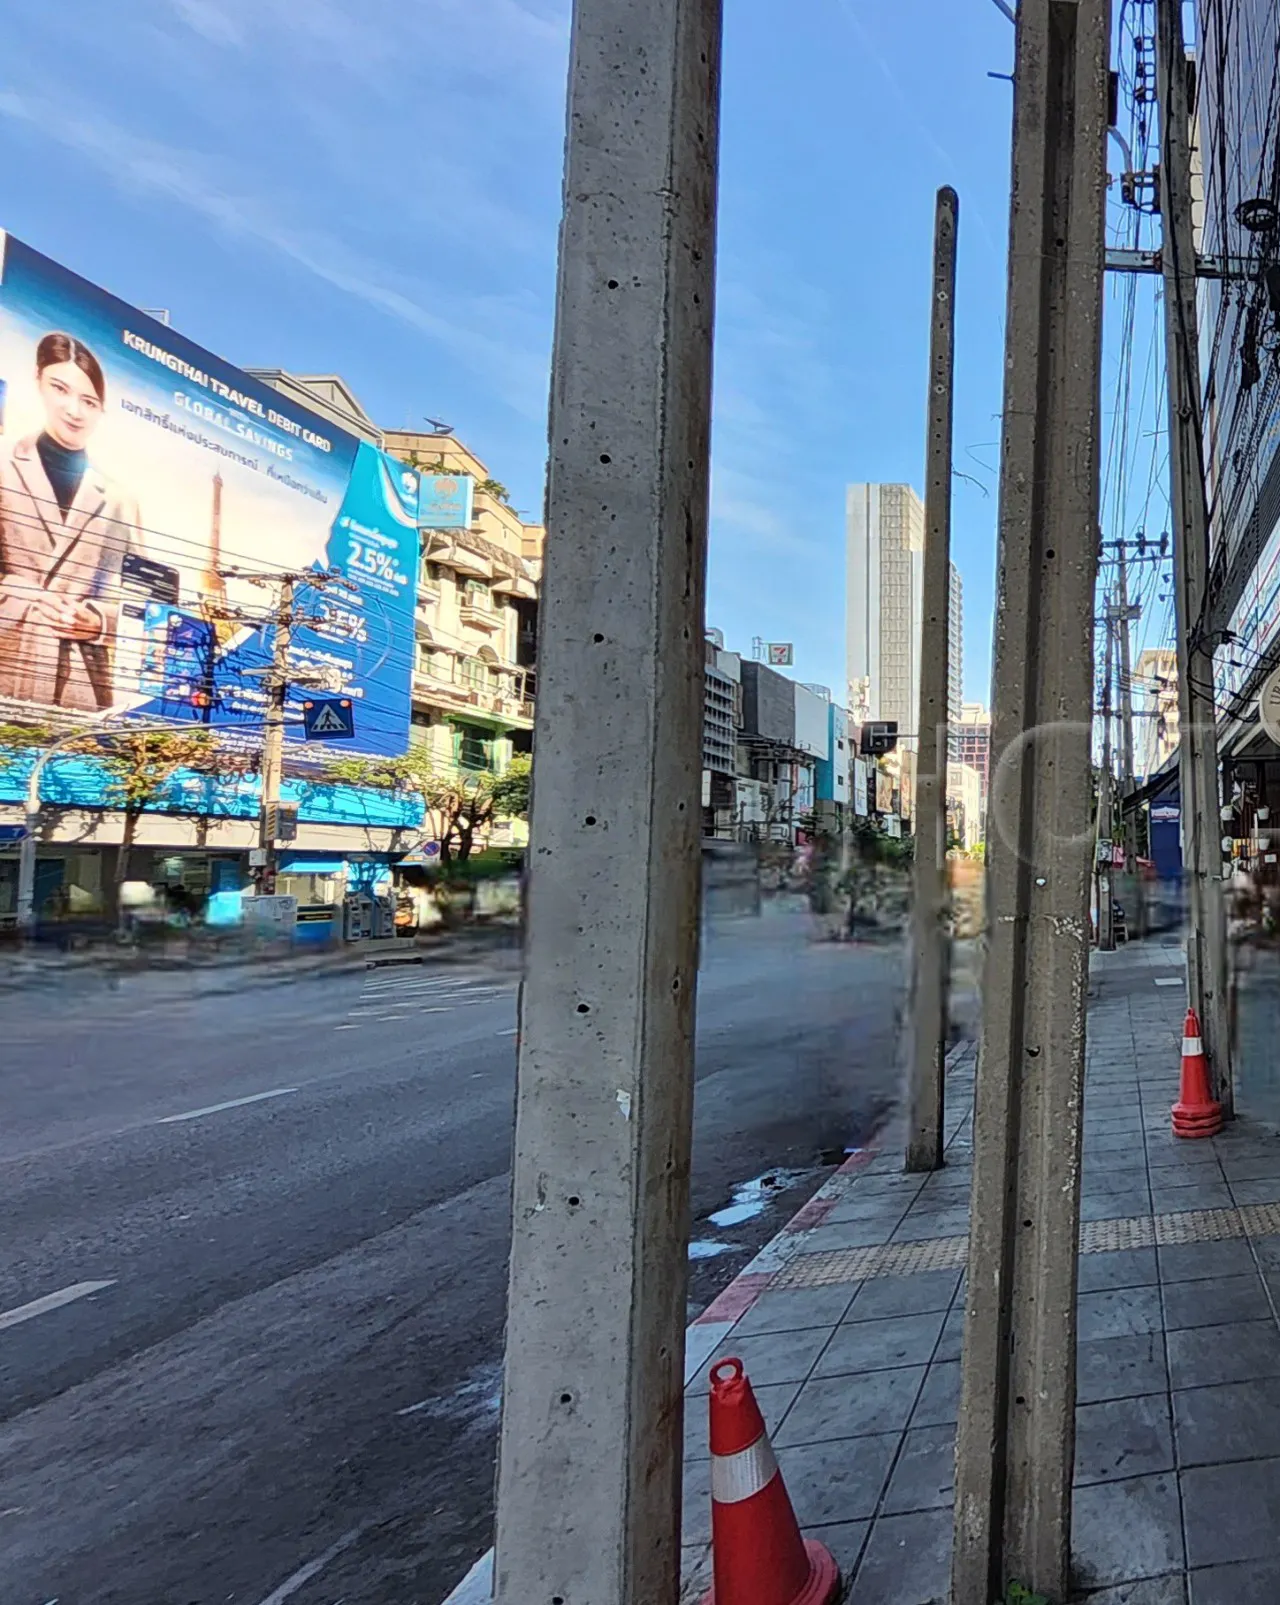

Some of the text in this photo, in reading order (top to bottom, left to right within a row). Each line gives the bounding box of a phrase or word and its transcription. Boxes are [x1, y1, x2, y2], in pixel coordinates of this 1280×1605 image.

[124, 329, 332, 453] KRUNGTHAI TRAVEL DEBIT CARD
[173, 391, 293, 461] GLOBAL SAVINGS
